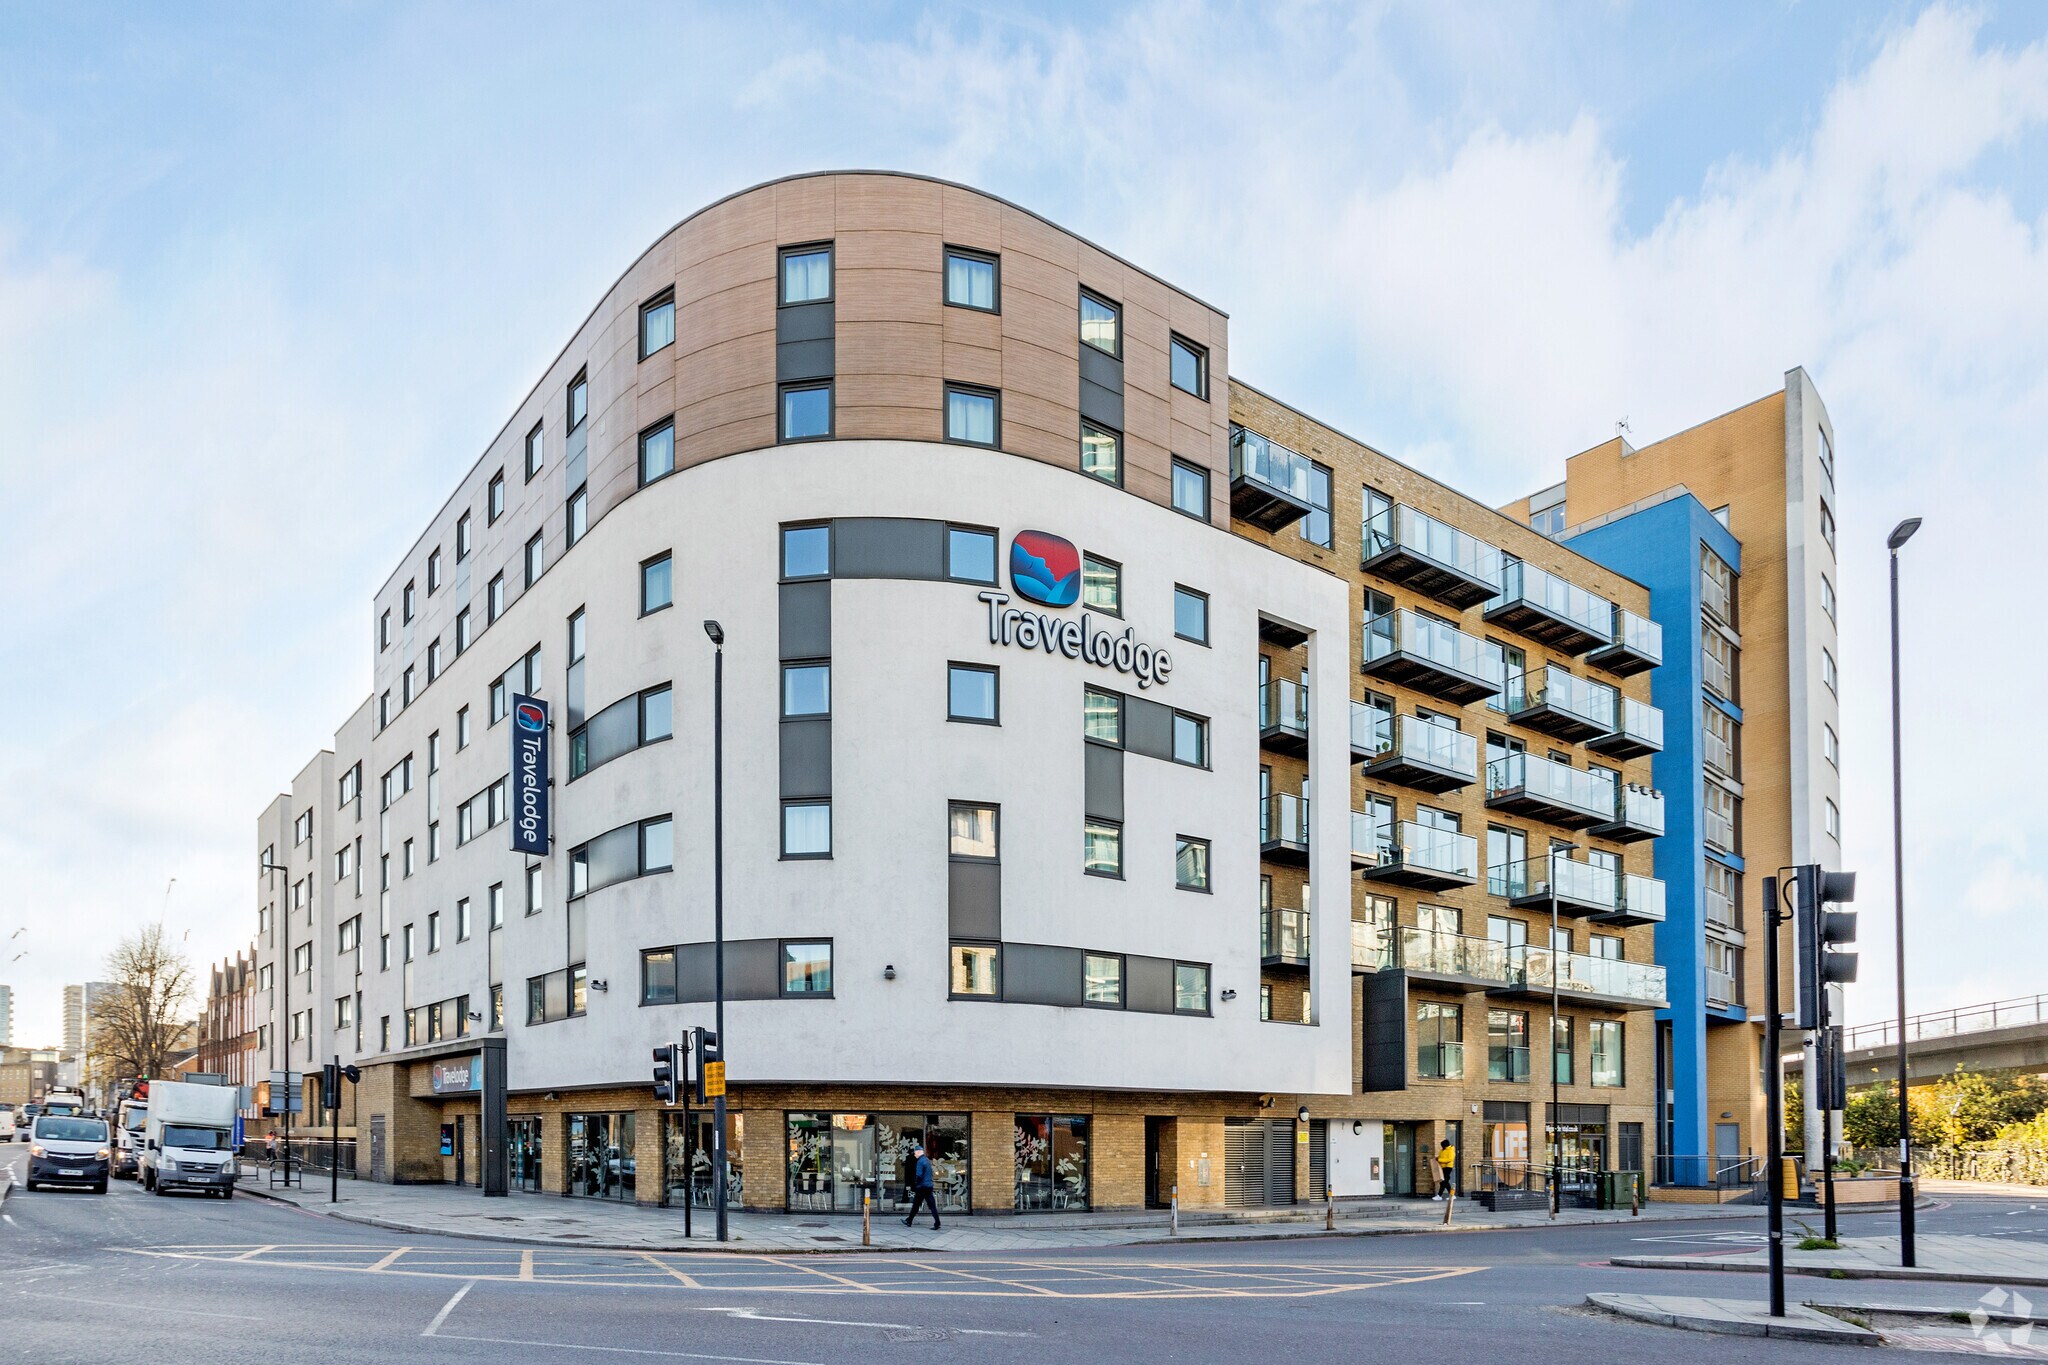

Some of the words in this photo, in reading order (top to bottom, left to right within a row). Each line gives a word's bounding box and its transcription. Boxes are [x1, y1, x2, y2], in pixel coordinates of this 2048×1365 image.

[978, 591, 1173, 690] Travelodge
[519, 737, 541, 843] Travelodge
[442, 1065, 469, 1087] Travelodge
